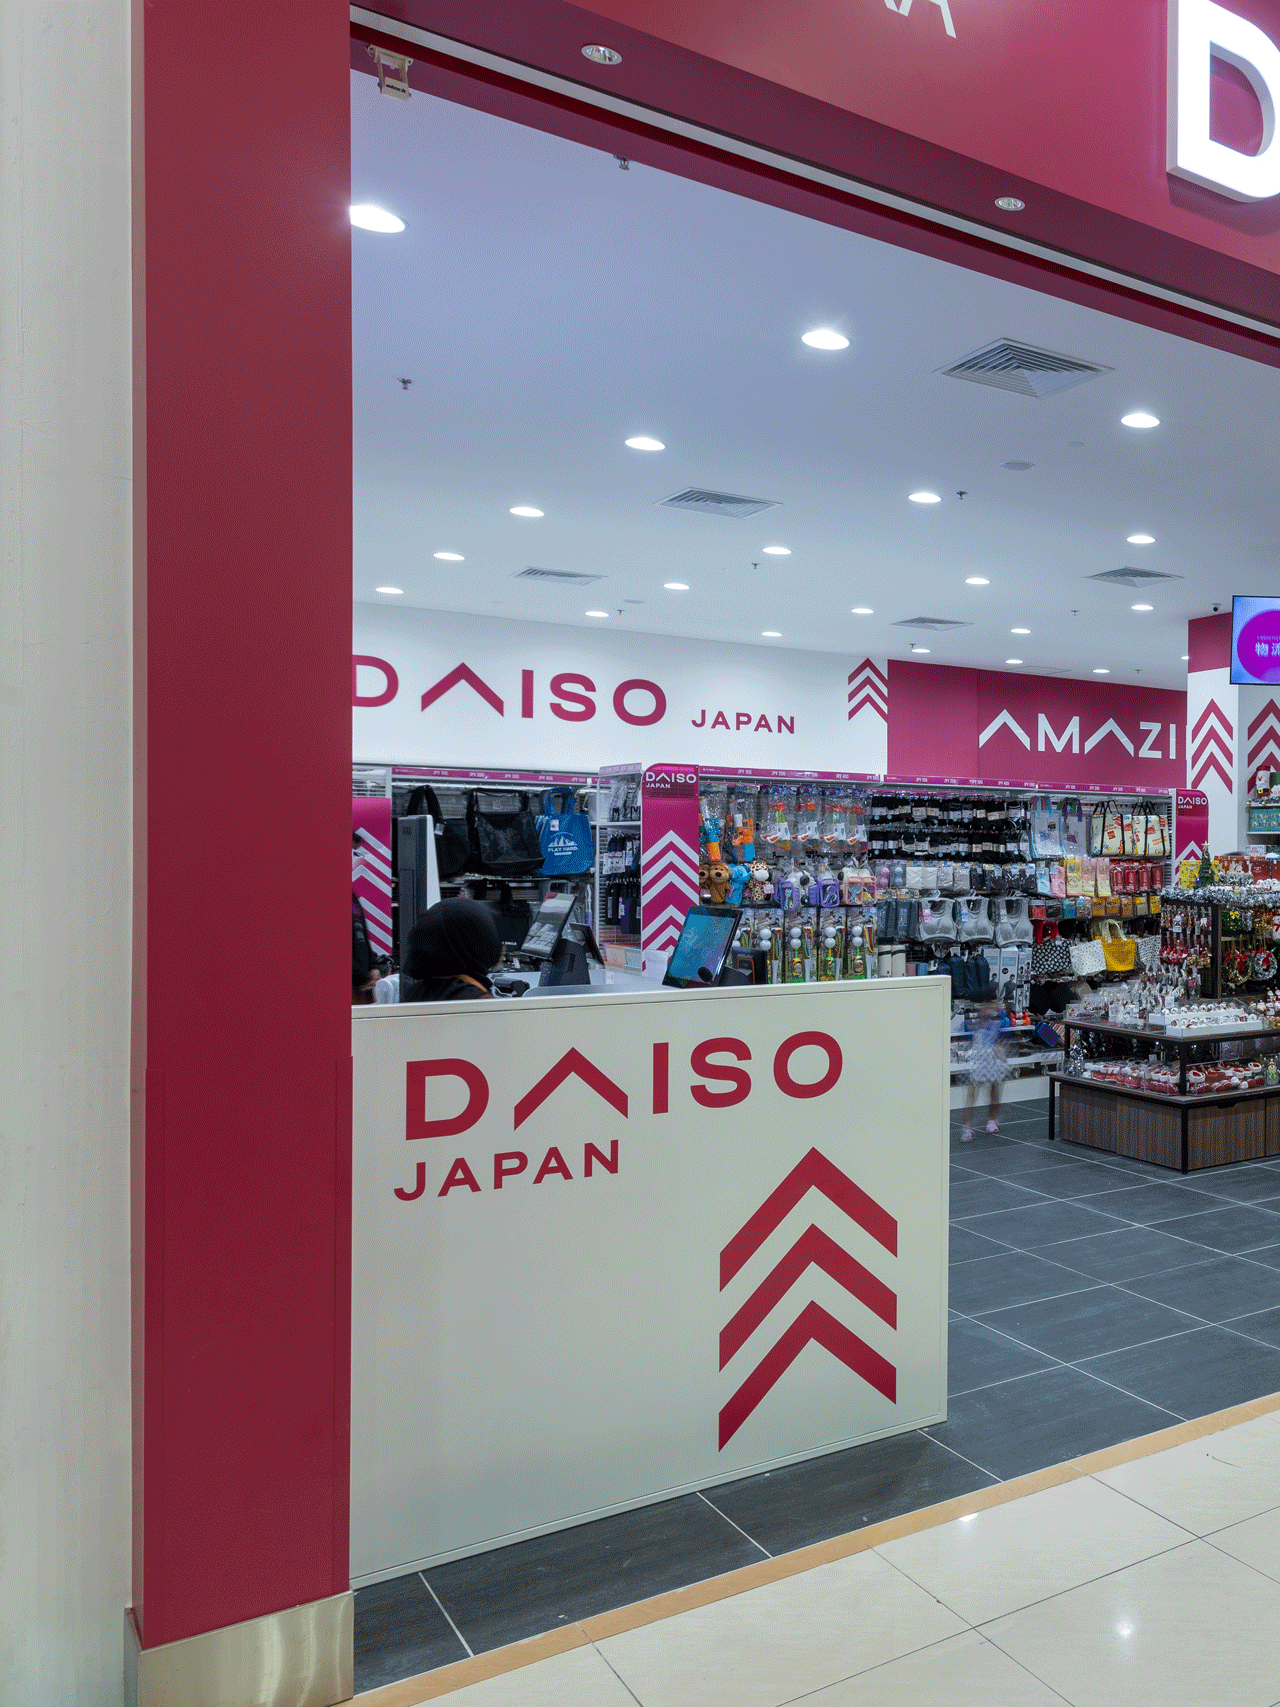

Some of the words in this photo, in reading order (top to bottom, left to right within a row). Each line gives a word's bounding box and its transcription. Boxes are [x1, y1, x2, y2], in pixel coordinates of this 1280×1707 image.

[353, 654, 667, 726] DAISO
[691, 709, 795, 735] JAPAN
[645, 771, 697, 784] DAISO
[1178, 796, 1208, 805] DAISO
[405, 1030, 843, 1140] DAISO
[393, 1139, 619, 1201] JAPAN
